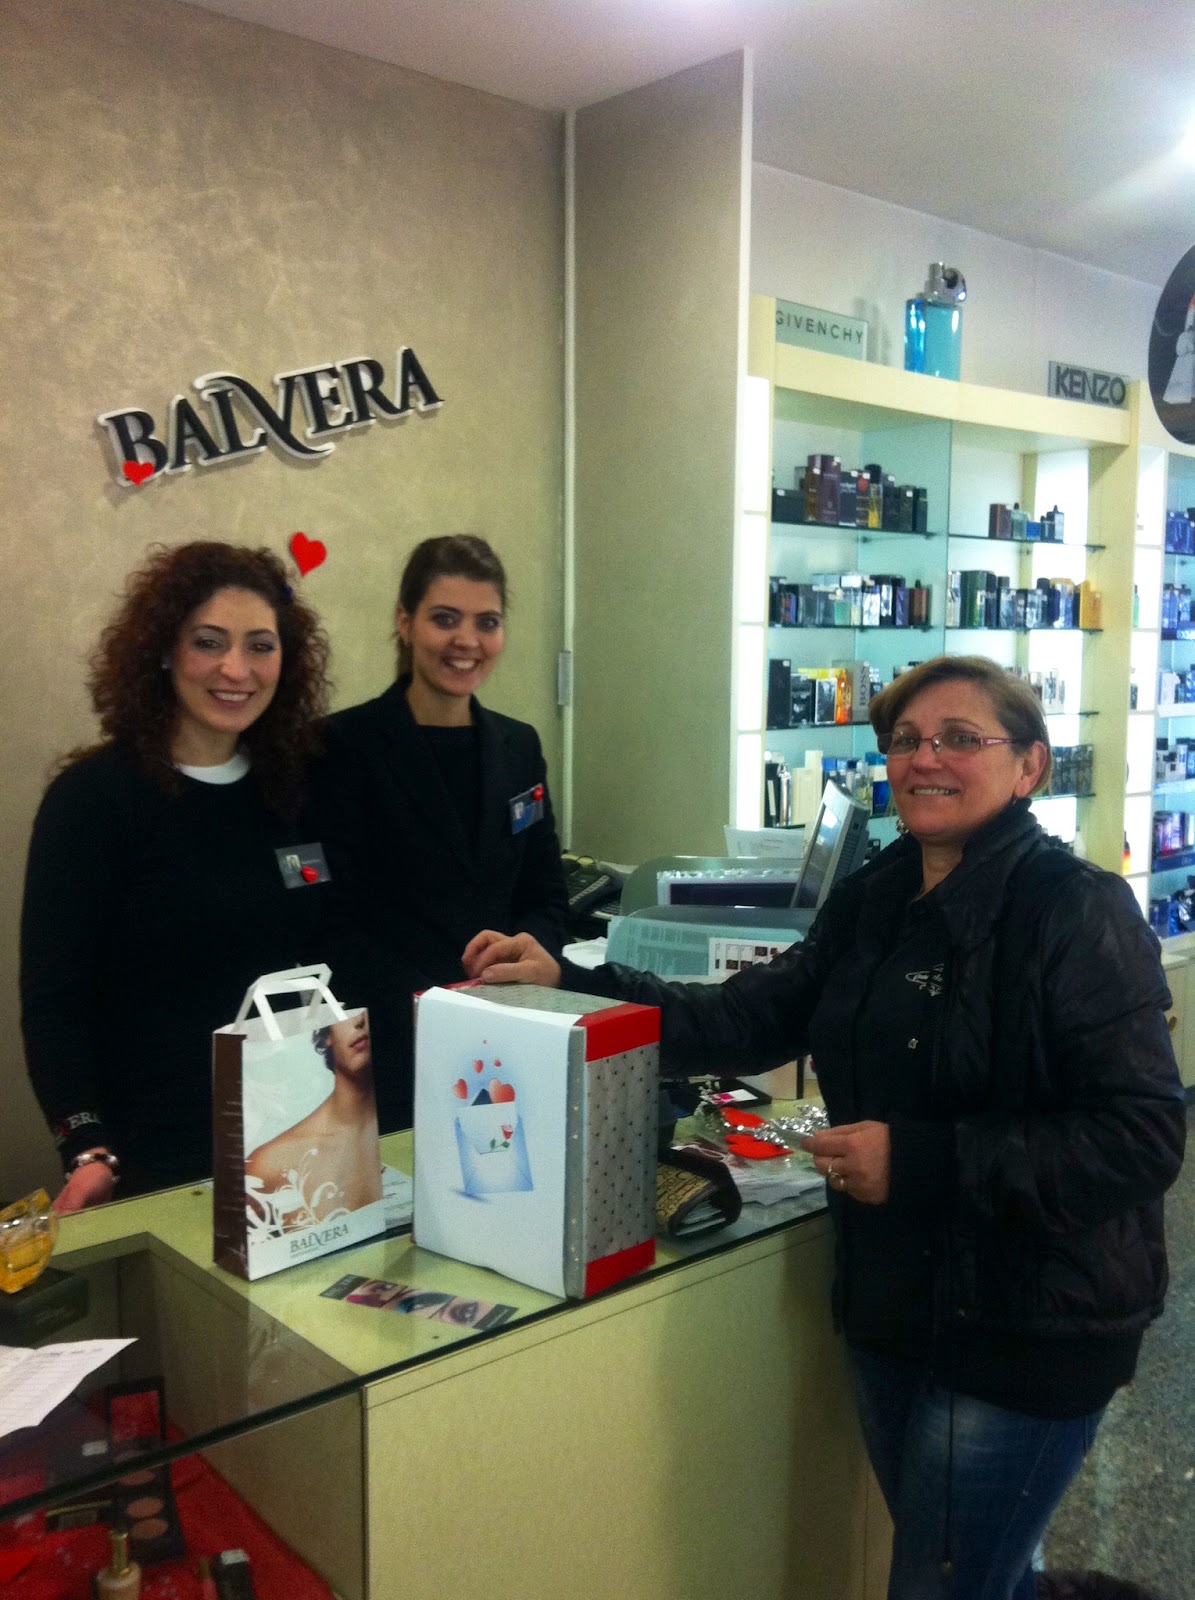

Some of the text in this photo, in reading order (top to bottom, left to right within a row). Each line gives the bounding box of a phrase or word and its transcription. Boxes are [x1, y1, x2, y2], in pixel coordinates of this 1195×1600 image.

[776, 310, 863, 343] GIVENCHY
[1055, 365, 1126, 405] KENZO
[98, 346, 445, 486] BALVERA
[290, 1223, 350, 1253] BALVERA
